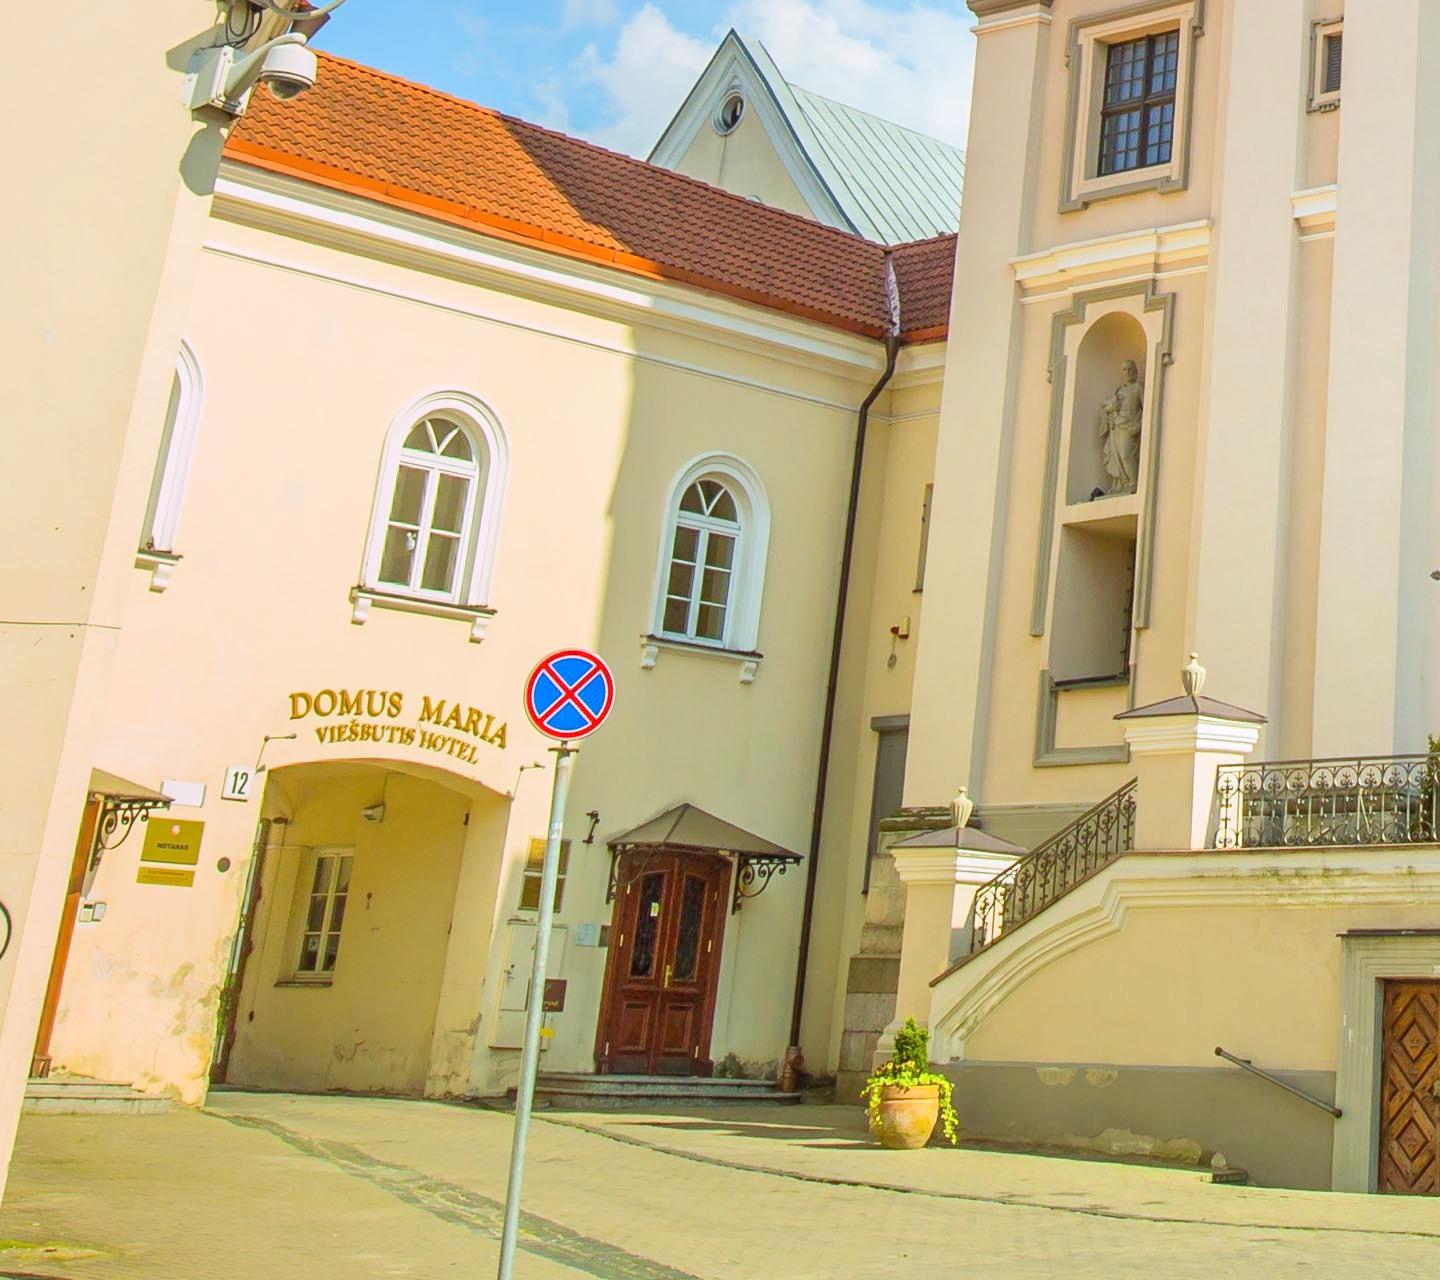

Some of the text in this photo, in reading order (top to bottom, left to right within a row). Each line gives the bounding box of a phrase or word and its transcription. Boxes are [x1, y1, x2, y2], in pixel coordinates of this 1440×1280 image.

[289, 689, 509, 750] DOMUS MARIA
[315, 718, 480, 765] VIEŠBUTIS HOTEL
[231, 771, 249, 795] 12
